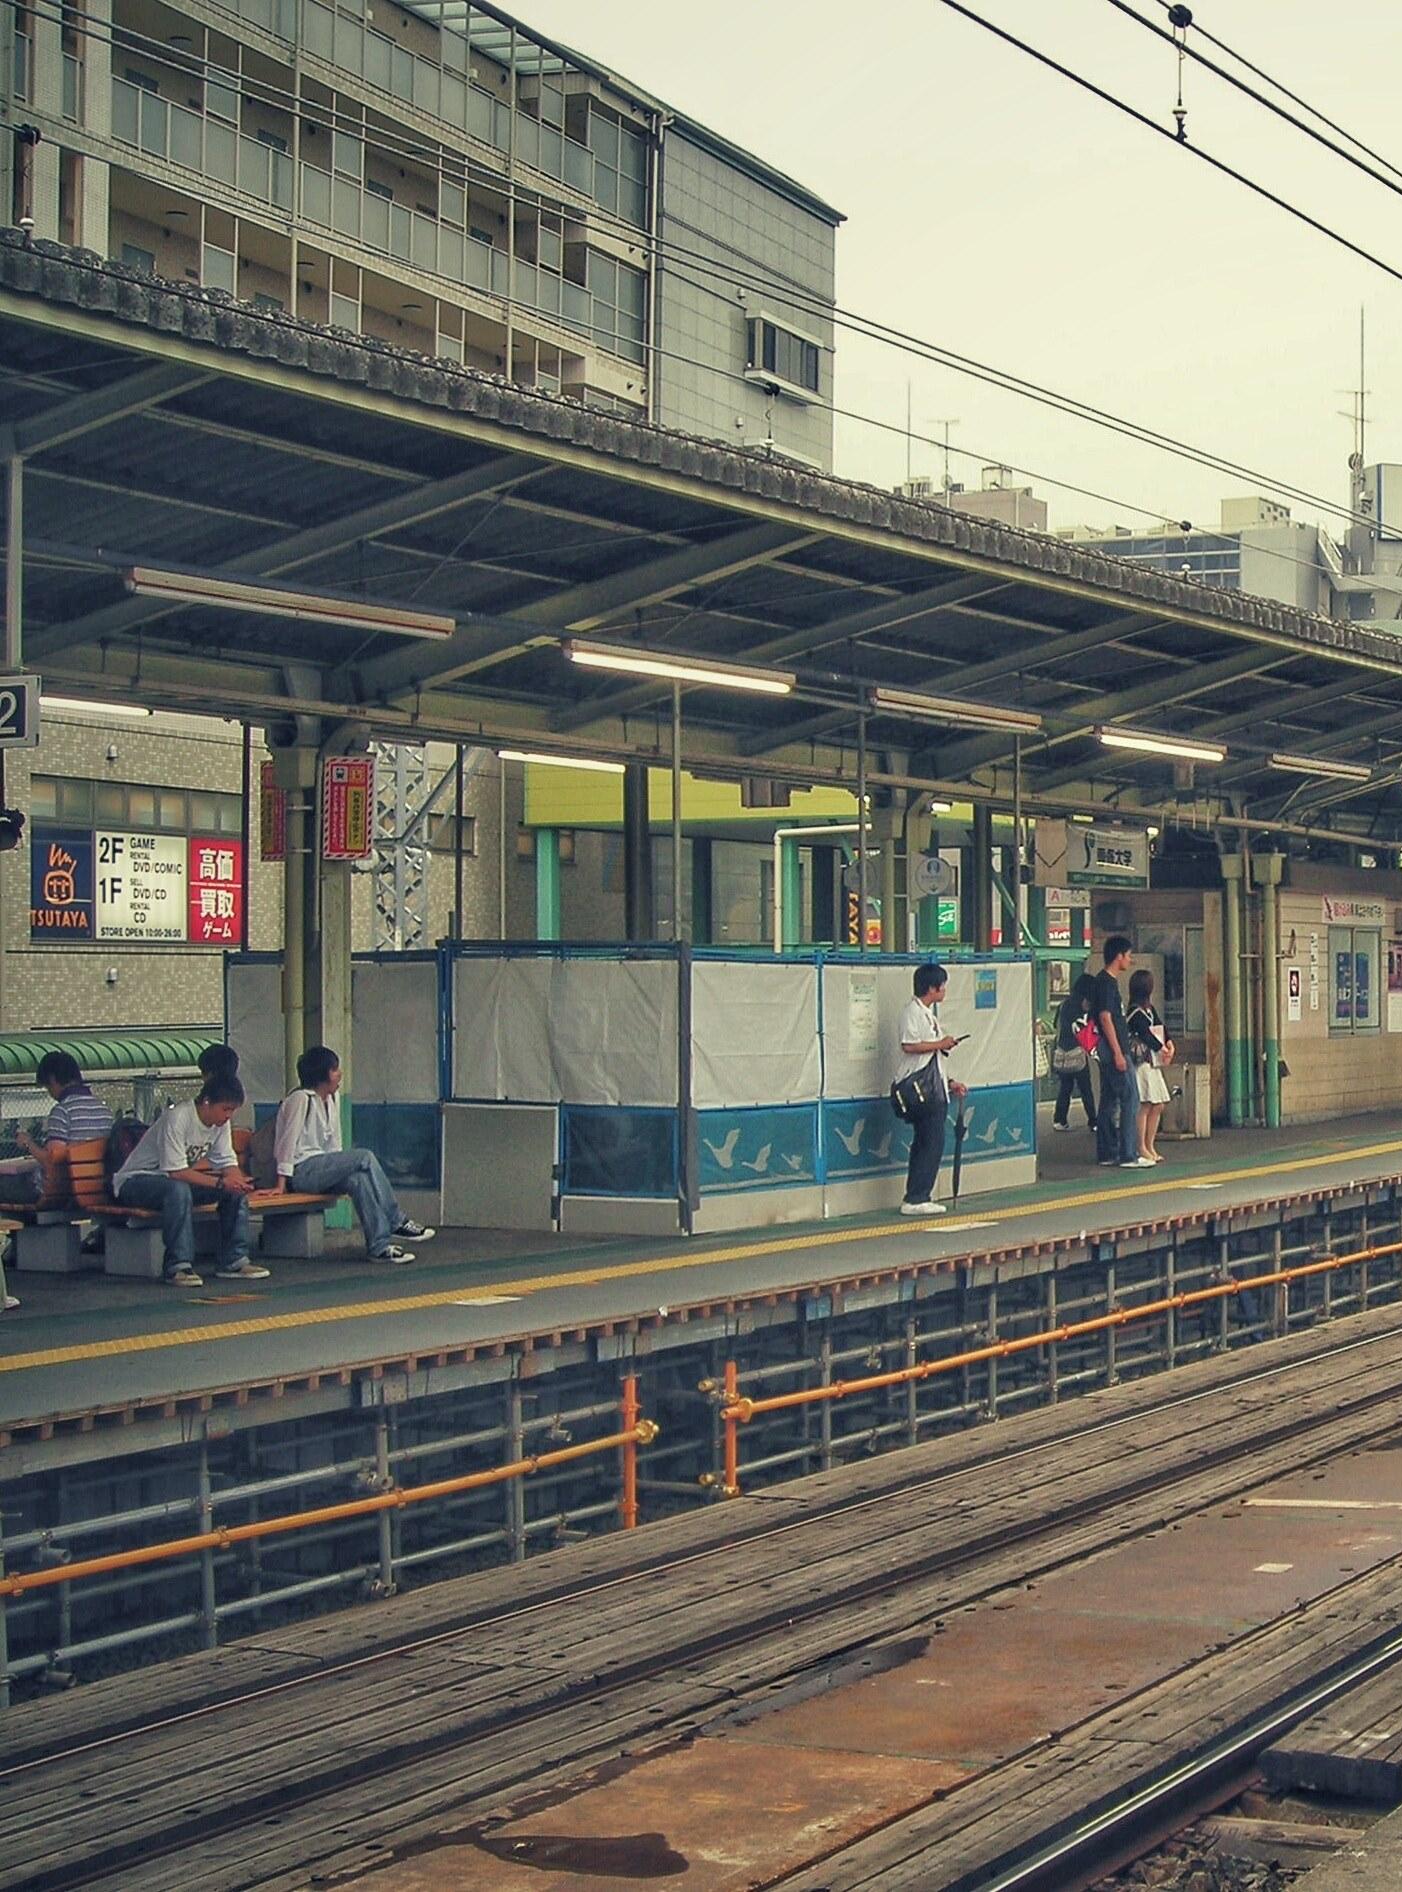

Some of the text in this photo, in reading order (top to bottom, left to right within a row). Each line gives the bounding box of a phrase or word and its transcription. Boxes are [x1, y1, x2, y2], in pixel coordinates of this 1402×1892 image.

[130, 837, 156, 850] GAME
[99, 837, 125, 864] 2F
[130, 851, 150, 860] RENTAL
[133, 861, 183, 875] DVD/COMIC
[199, 848, 234, 881] 高価
[130, 878, 143, 886] SELL
[99, 877, 122, 904] 1F
[133, 887, 167, 900] DVD/CD
[130, 902, 150, 911] RENTAL
[200, 889, 235, 919] 買取
[31, 909, 88, 928] TSUTAYA
[134, 911, 146, 924] CD
[101, 926, 123, 937] STORE
[125, 927, 143, 937] OPEN
[203, 922, 233, 939] ゲーム
